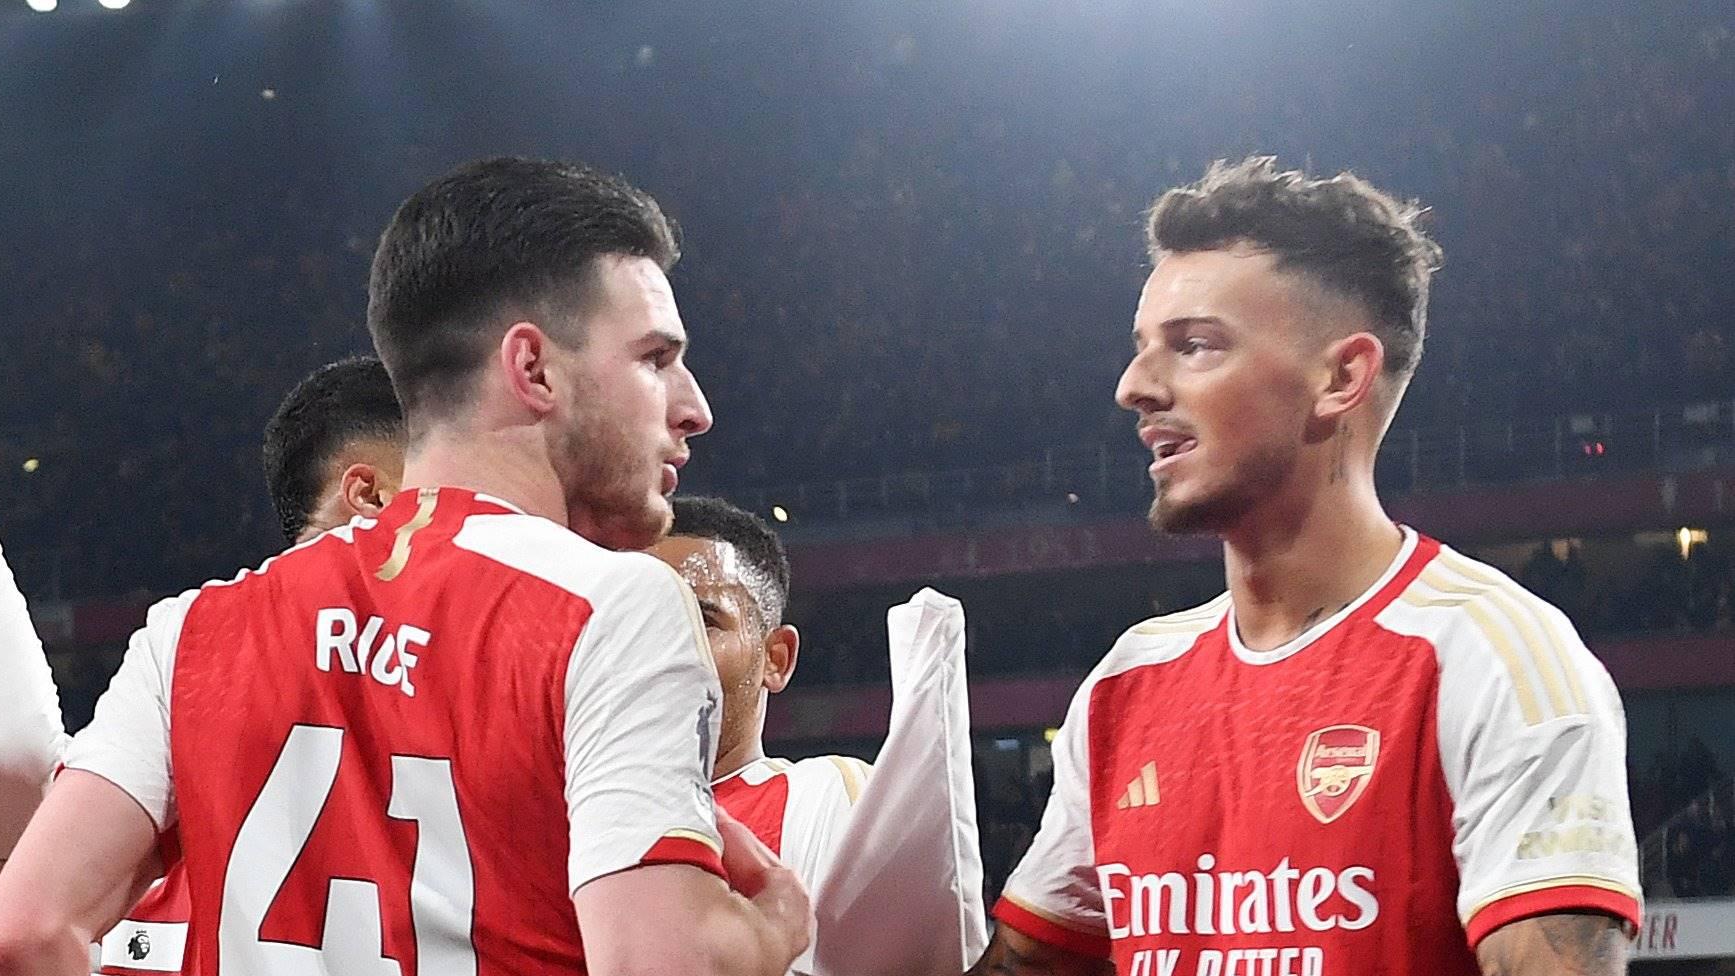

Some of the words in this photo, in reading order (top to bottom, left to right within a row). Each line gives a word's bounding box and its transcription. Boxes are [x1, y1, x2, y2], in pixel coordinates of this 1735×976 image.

[315, 606, 432, 698] RICE
[1314, 743, 1365, 760] Arsenal
[1095, 852, 1380, 940] Emirates
